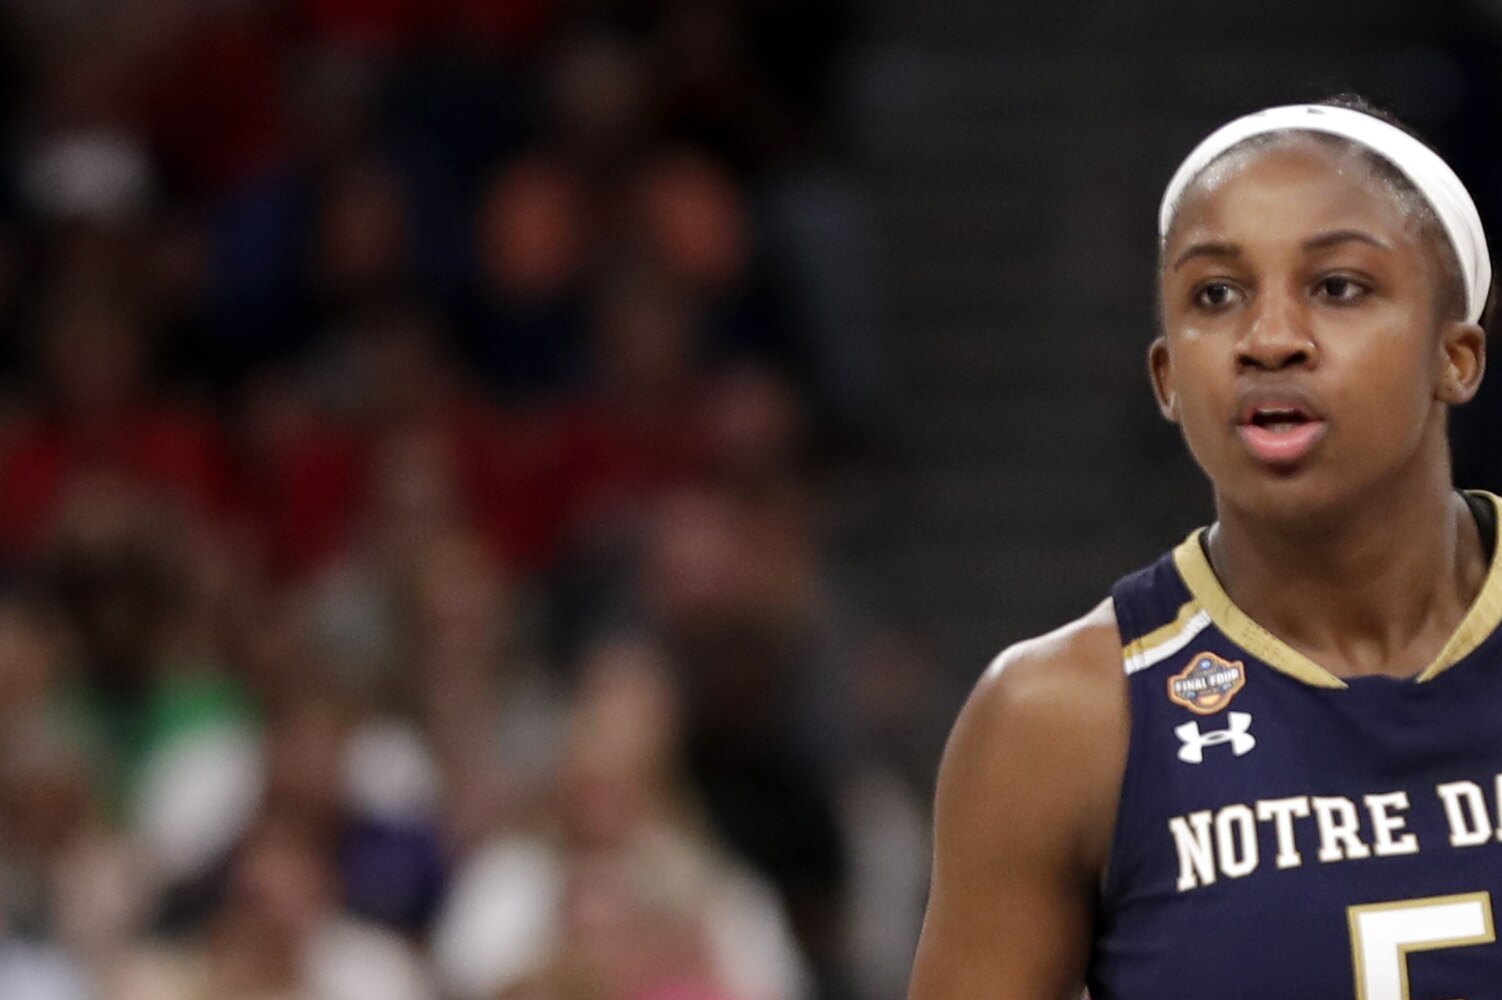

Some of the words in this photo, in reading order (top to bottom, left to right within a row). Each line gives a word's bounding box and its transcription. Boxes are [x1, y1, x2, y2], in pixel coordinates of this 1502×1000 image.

[1175, 679, 1207, 692] FINAL
[1210, 668, 1239, 685] FOUR
[1168, 791, 1419, 890] NOTRE
